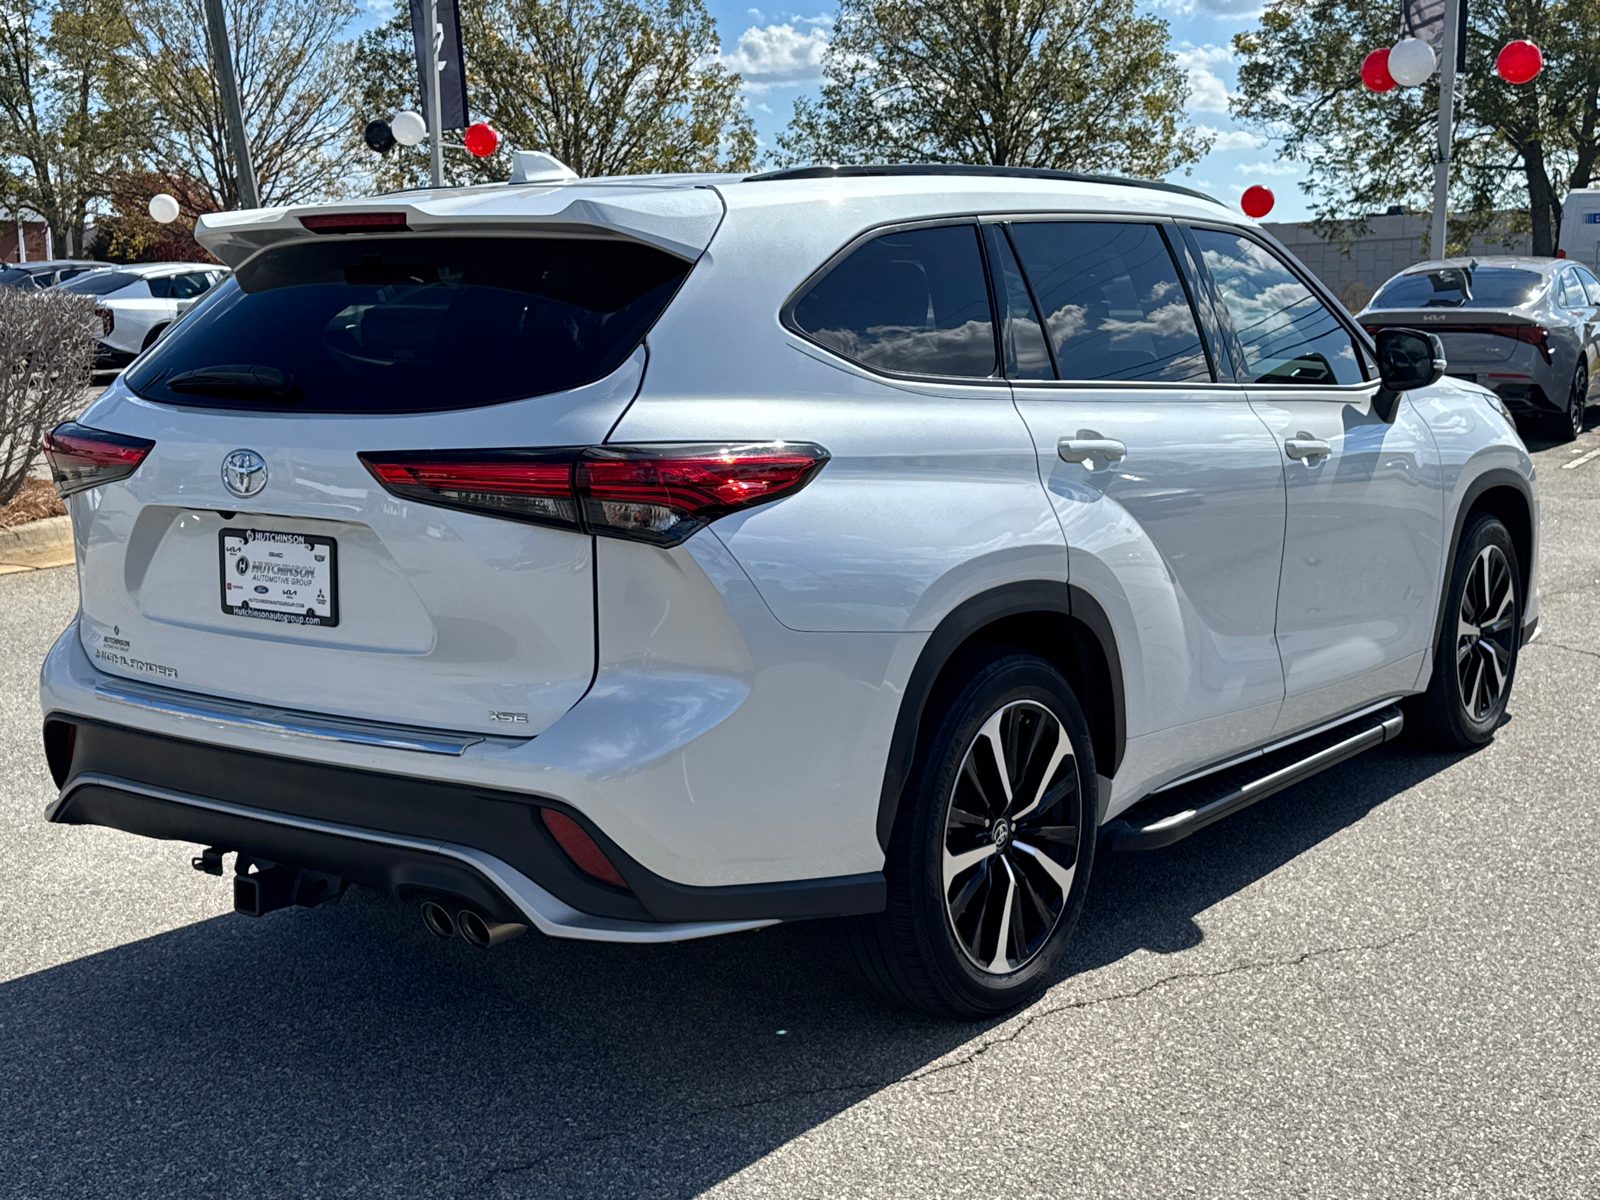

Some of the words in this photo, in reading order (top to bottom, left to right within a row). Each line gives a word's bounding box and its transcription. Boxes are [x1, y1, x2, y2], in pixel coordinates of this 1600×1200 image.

[255, 531, 304, 544] HUTCHINSON
[251, 561, 315, 579] HUTCHINSON
[252, 574, 289, 585] AUTOMOTIVE
[291, 578, 312, 587] GROUP
[233, 607, 321, 625] Hutchinsonautogroup.com
[95, 649, 178, 678] HIGHLANDER
[488, 710, 529, 724] XSE
[928, 738, 964, 841] YOKOHAMA
